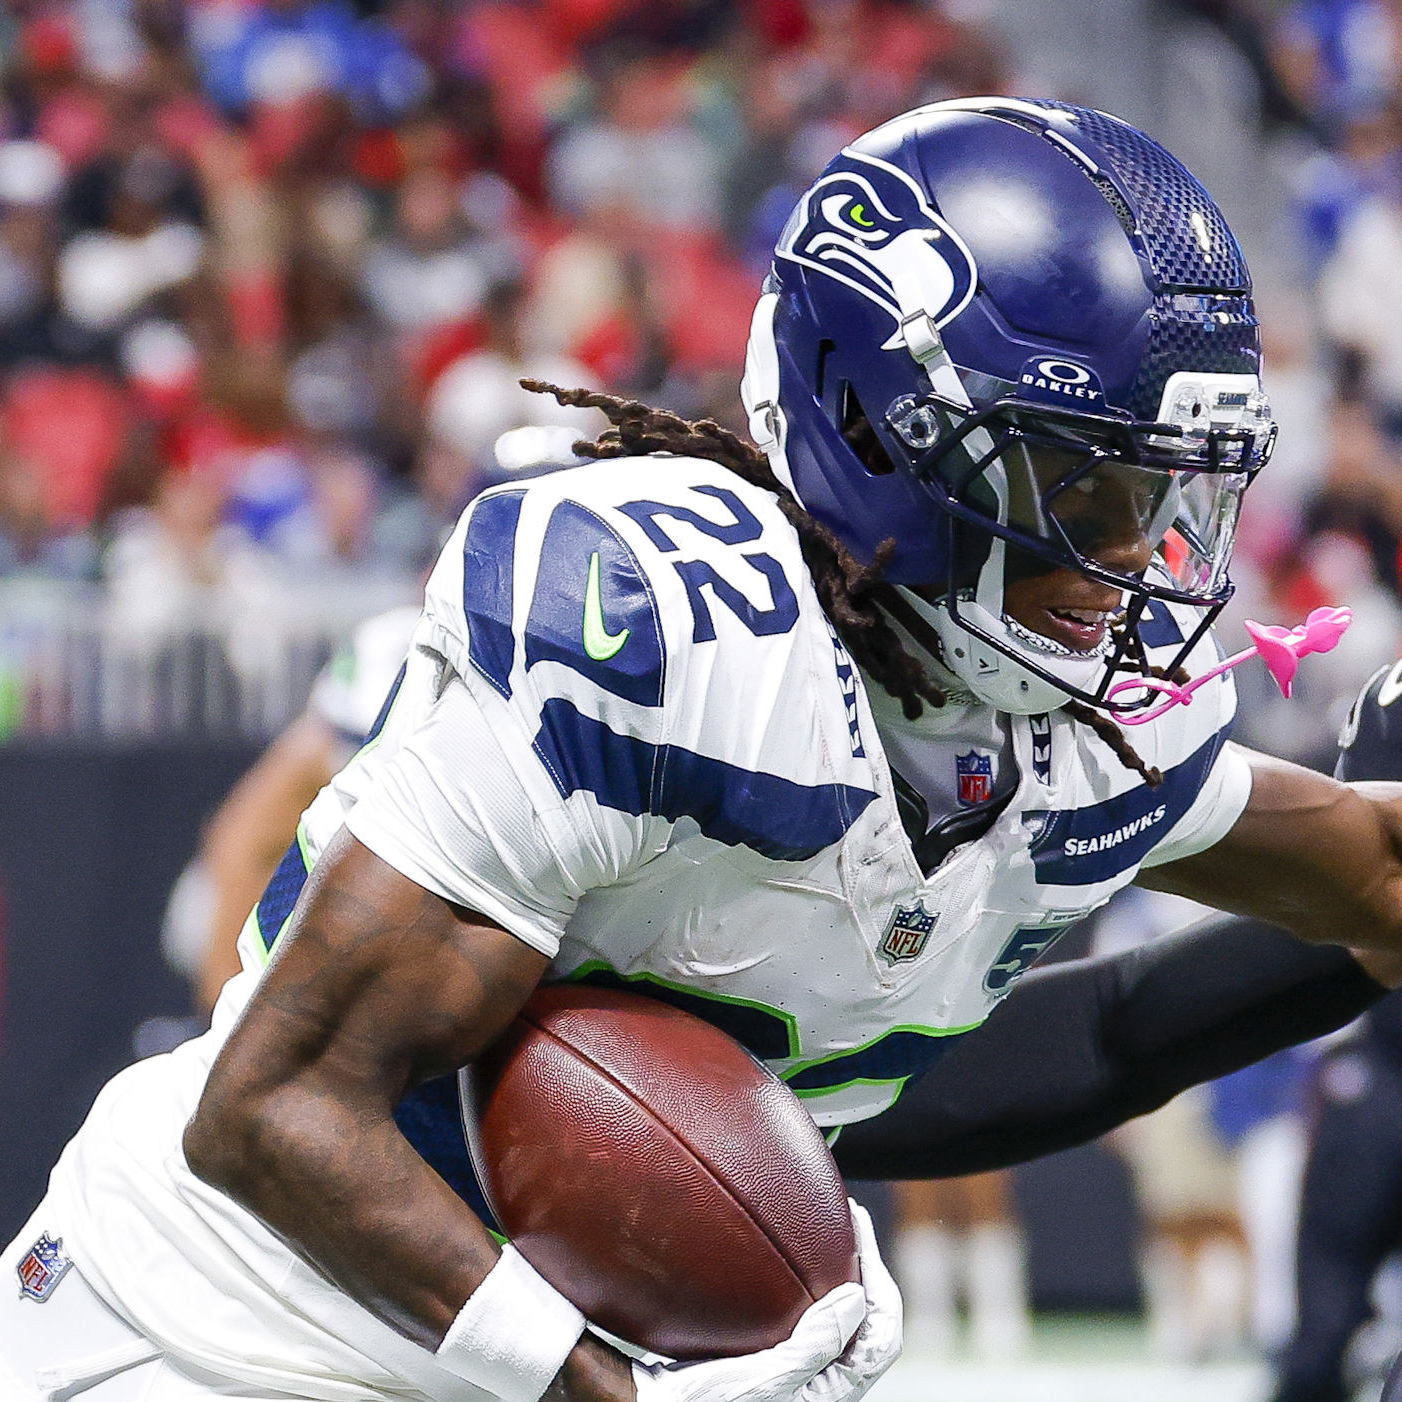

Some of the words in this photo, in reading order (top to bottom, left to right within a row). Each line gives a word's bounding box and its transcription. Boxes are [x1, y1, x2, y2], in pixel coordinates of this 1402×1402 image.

[1022, 373, 1099, 400] OAKLEY
[612, 484, 800, 644] 22
[959, 775, 992, 803] NFL
[1064, 803, 1167, 857] SEAHAWKS
[887, 929, 923, 956] NFL
[19, 1255, 49, 1293] NFL
